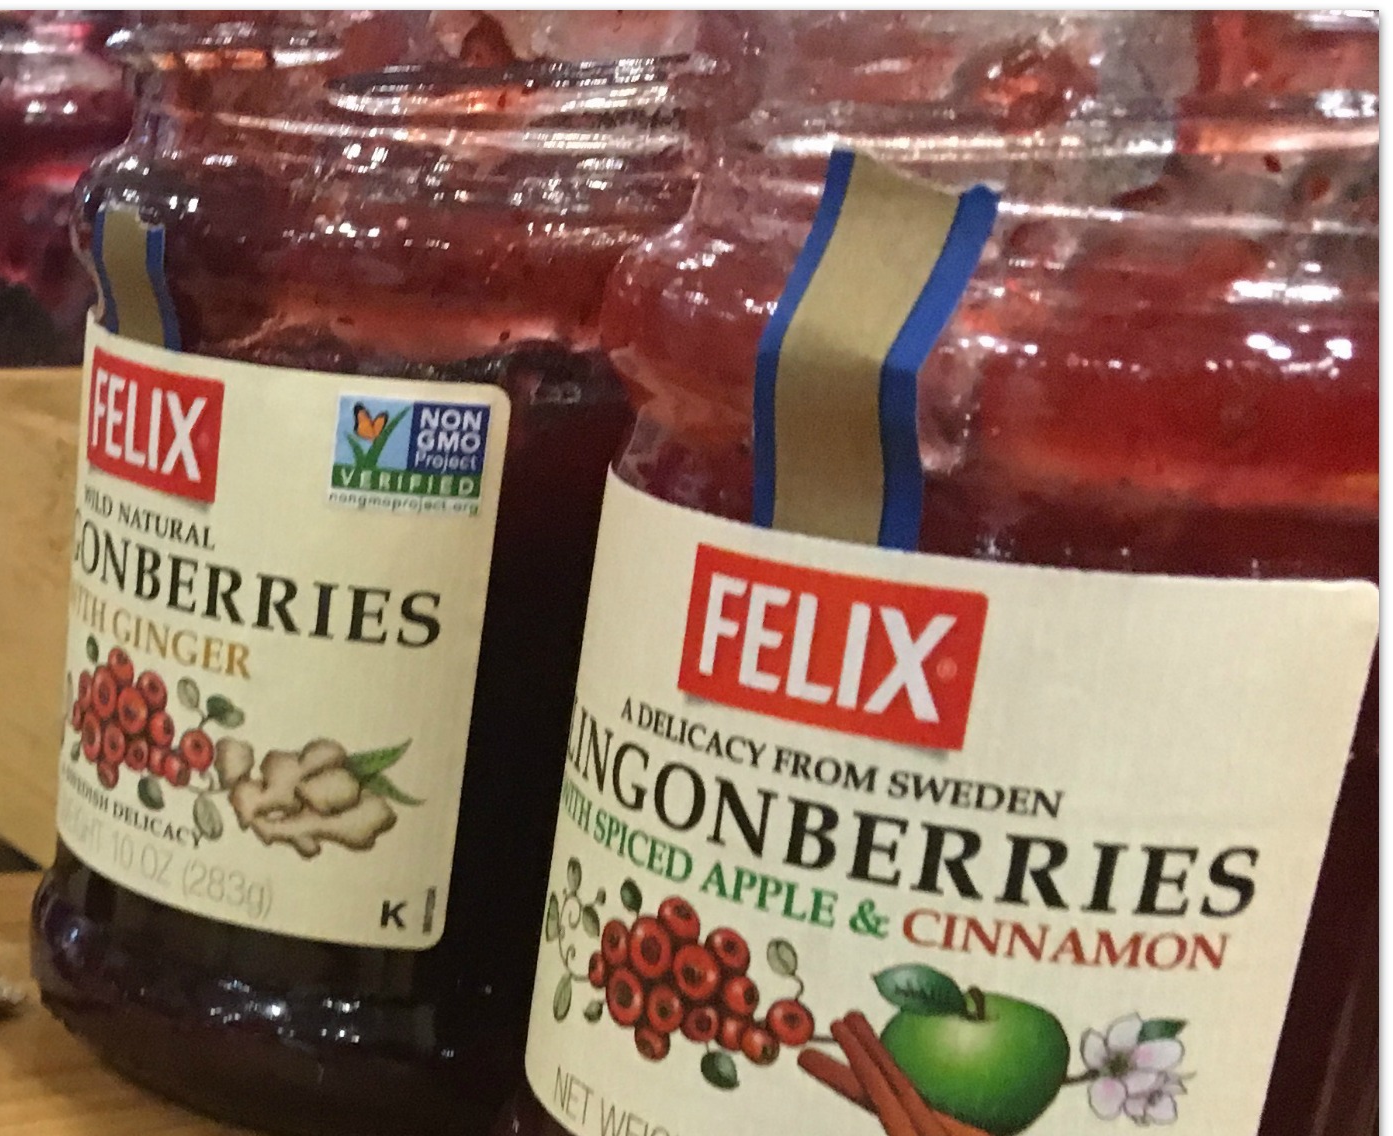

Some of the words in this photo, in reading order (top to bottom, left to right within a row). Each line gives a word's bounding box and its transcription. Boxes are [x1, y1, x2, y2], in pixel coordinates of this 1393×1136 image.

[91, 367, 207, 482] FELIX
[417, 429, 481, 454] GMO
[419, 406, 483, 431] NON
[340, 467, 474, 496] VERIFIED
[414, 449, 479, 474] Project
[118, 501, 216, 551] NATURAL
[329, 491, 479, 518] nongmoproject.org
[112, 607, 251, 679] GINGER
[698, 570, 958, 724] FELIX
[621, 696, 633, 724] A
[638, 701, 766, 767] DELICACY
[773, 743, 879, 793] FROM
[887, 768, 1065, 819] SWEDEN
[113, 799, 206, 848] DELICACY
[111, 830, 134, 872] 10
[140, 842, 175, 887] OZ
[182, 857, 274, 920] (283g)
[594, 806, 693, 883] SPICED
[699, 859, 838, 928] APPLE
[849, 898, 890, 940] &
[902, 907, 1231, 971] CINNAMON
[380, 899, 408, 930] K
[554, 1065, 595, 1128] NET
